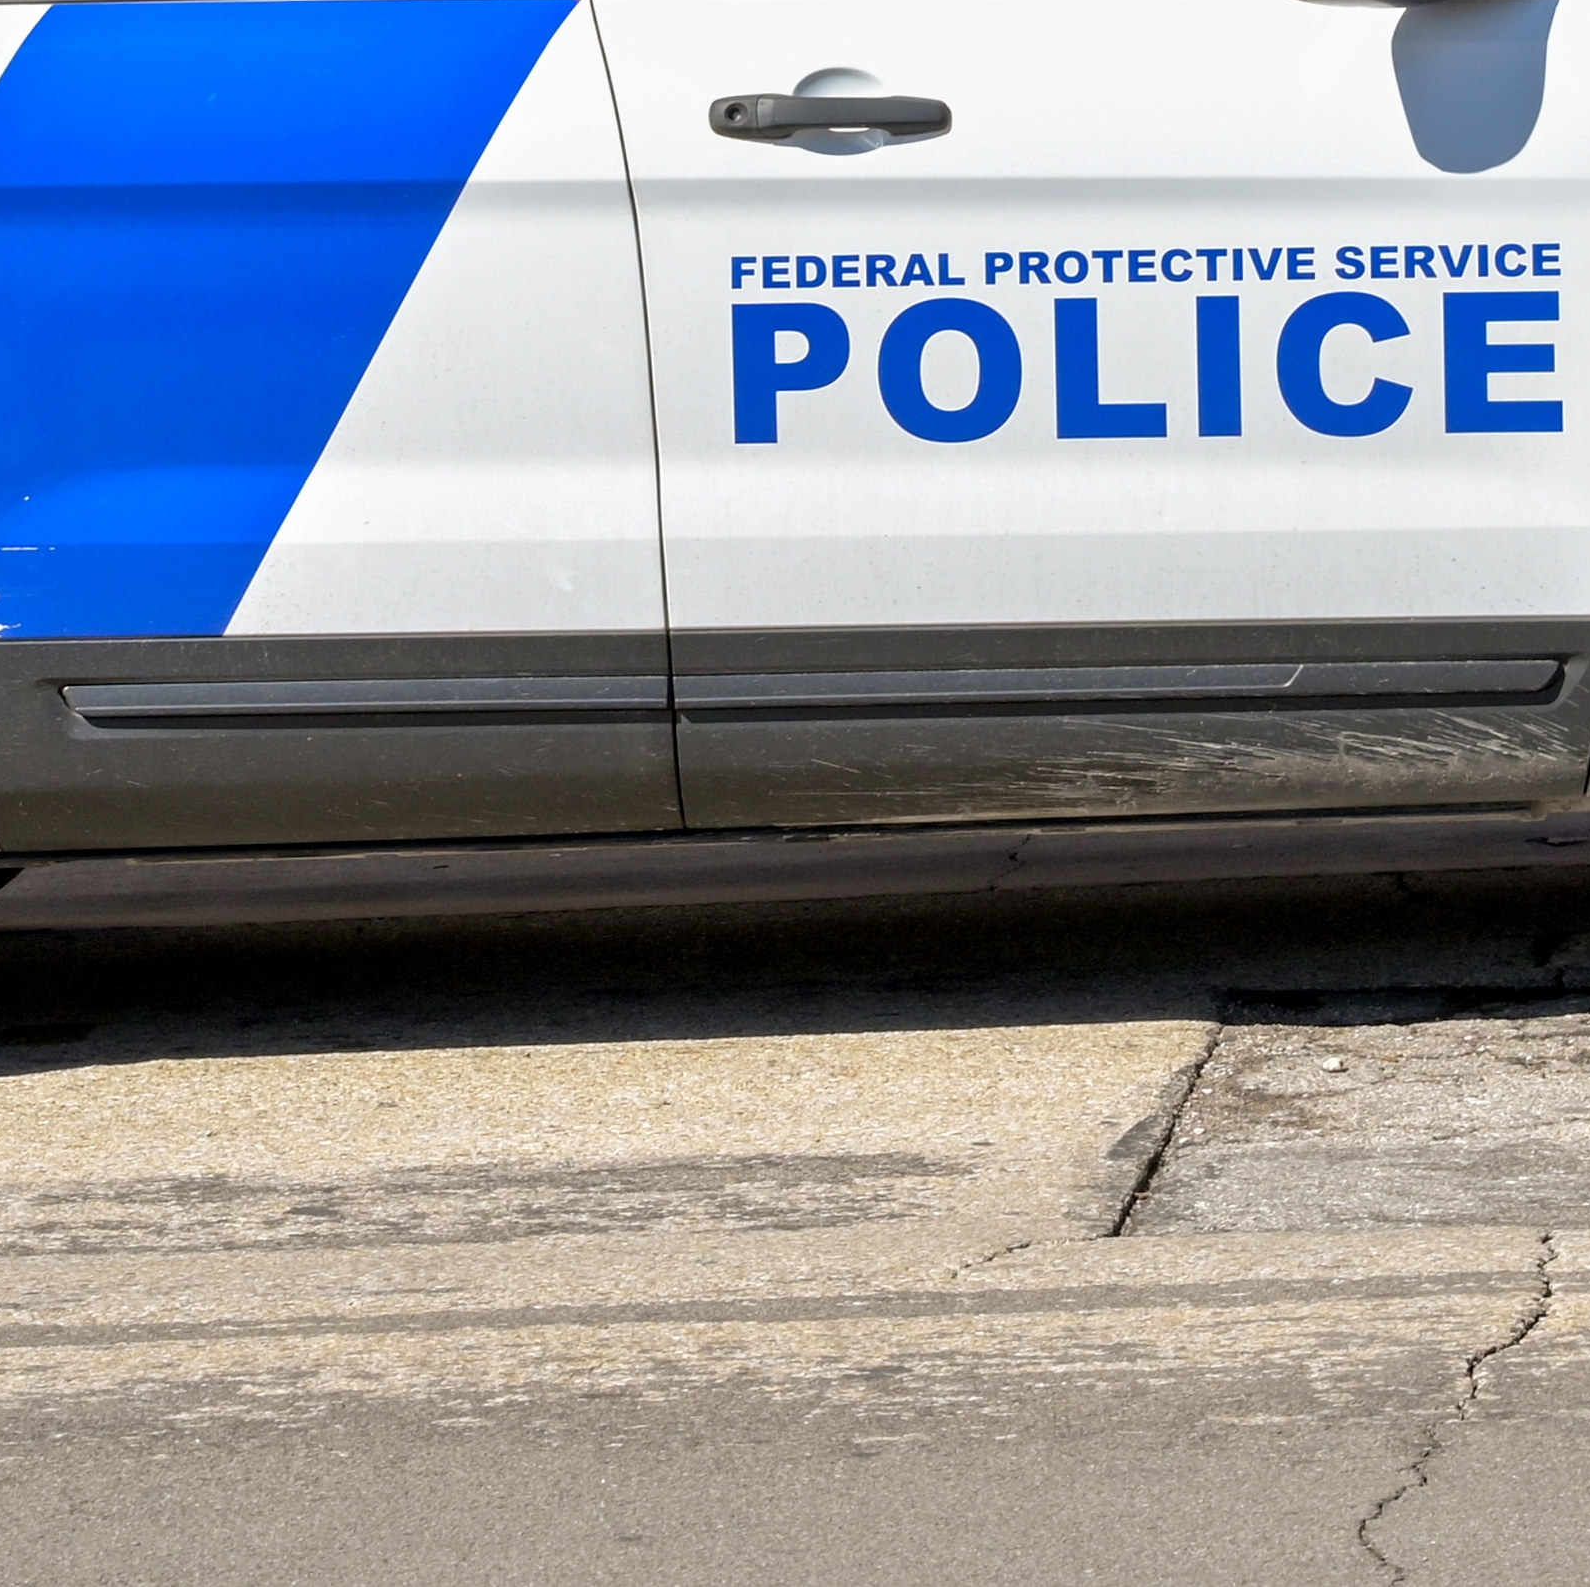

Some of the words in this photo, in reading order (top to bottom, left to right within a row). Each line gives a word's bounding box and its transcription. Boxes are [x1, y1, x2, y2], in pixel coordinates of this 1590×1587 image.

[729, 253, 967, 289] FEDERAL
[984, 247, 1316, 286] PROTECTIVE
[1334, 243, 1563, 280] SERVICE
[730, 290, 1565, 445] POLICE
